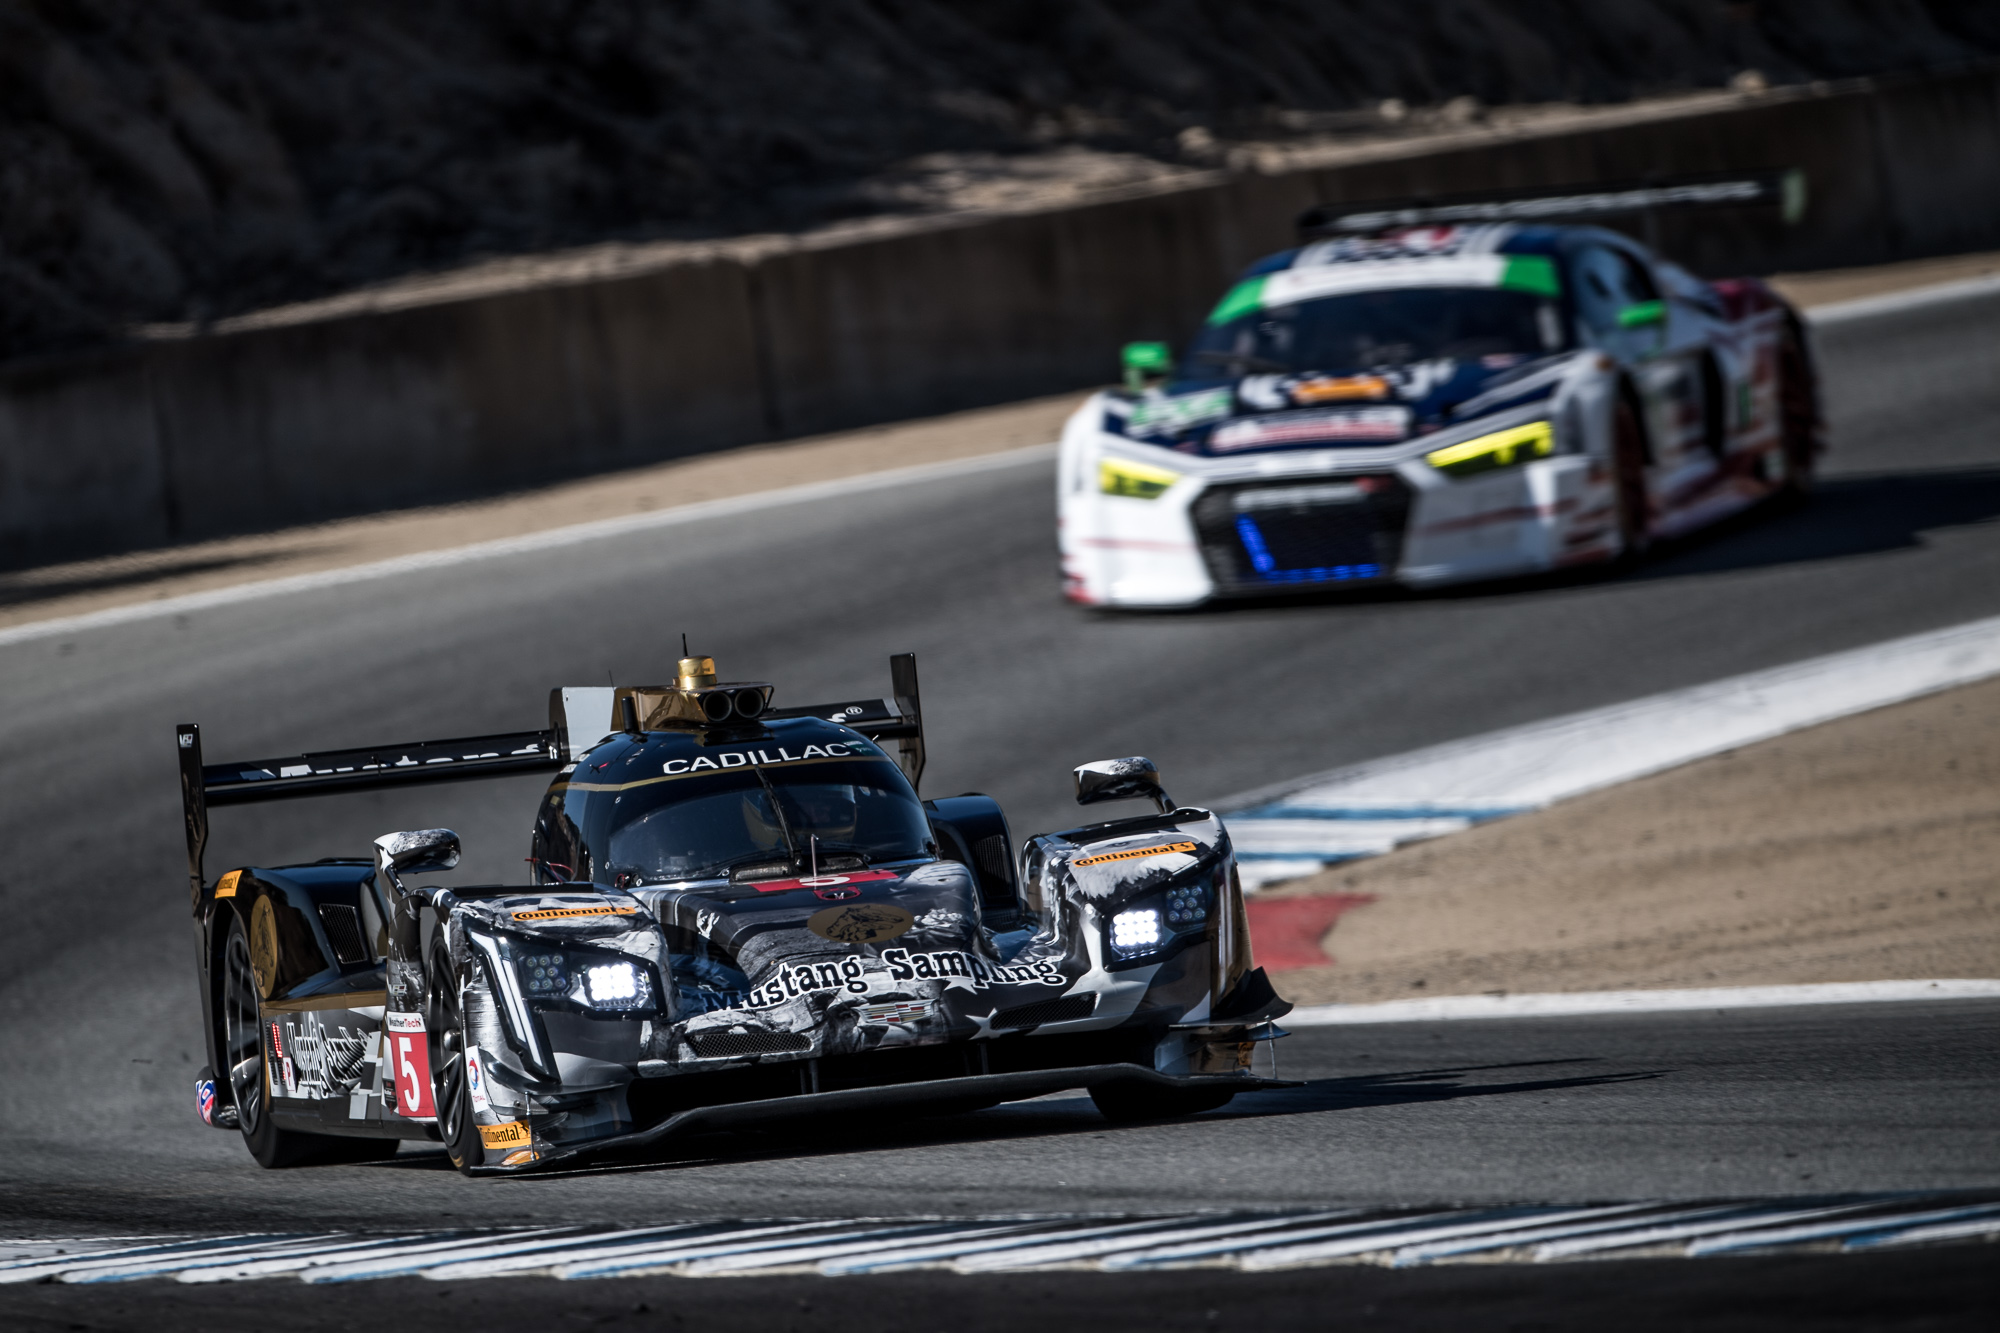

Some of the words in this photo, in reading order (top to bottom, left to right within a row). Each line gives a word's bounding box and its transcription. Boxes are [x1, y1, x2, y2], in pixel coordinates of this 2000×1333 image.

[663, 743, 851, 774] CADILLAC
[1074, 845, 1176, 867] Continental
[514, 906, 616, 920] Continental
[702, 955, 869, 1012] Mustang
[882, 948, 1067, 989] Sampling
[398, 1036, 421, 1112] 5
